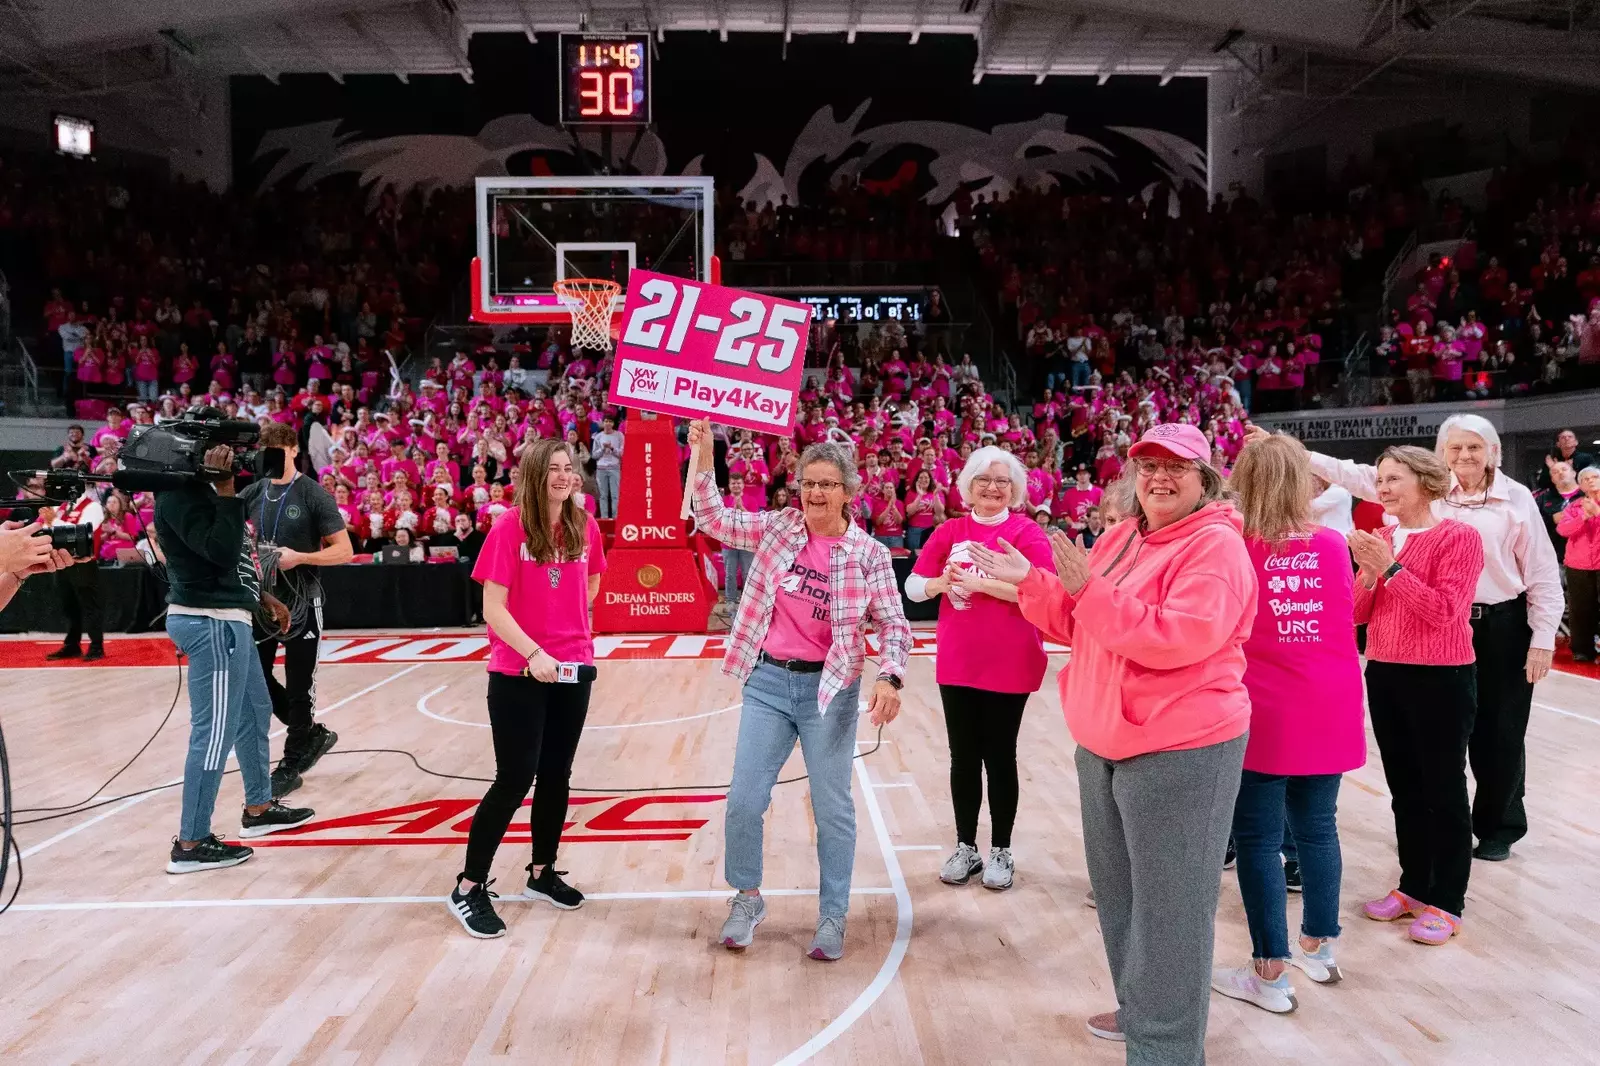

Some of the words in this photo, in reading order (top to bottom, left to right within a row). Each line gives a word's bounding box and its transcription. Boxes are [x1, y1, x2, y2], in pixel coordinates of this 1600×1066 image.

[579, 44, 640, 69] 11:46
[580, 72, 633, 115] 30
[623, 278, 808, 374] 21-25
[634, 368, 657, 379] KAY
[673, 376, 789, 420] Play4Kay
[1308, 420, 1330, 430] AND
[1334, 417, 1372, 429] DWAIN
[1376, 416, 1417, 427] LANIER
[1300, 428, 1366, 440] BASKETBALL
[1371, 426, 1413, 437] LOCKER
[645, 443, 652, 463] NC
[645, 467, 653, 519] STATE
[641, 526, 677, 540] PNC
[1264, 552, 1320, 571] Coca-Cola
[1304, 577, 1322, 589] NC
[605, 592, 648, 605] DREAM
[649, 592, 695, 604] FINDERS
[630, 605, 670, 616] HOMES
[1268, 598, 1323, 617] Bojangles
[1277, 620, 1319, 635] UNC
